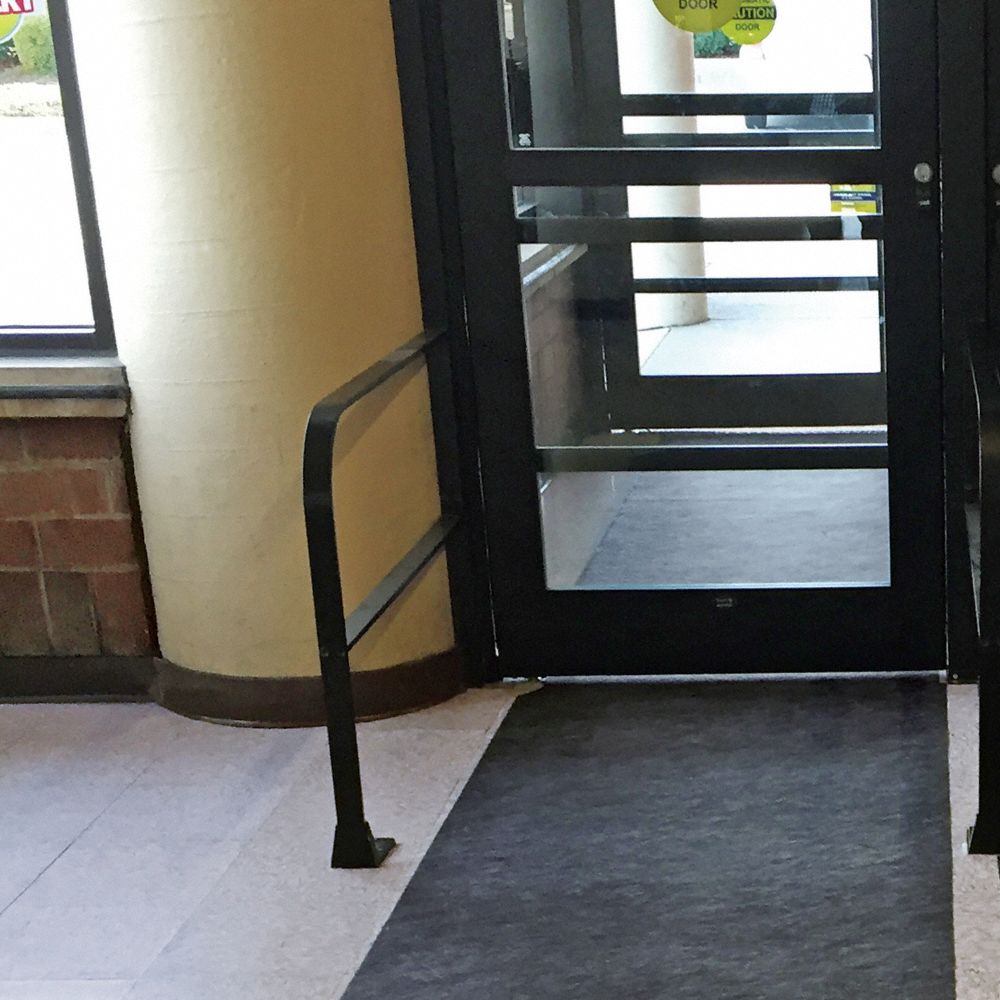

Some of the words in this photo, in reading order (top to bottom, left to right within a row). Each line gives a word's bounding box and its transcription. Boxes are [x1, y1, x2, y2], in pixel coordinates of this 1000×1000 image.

[679, 0, 718, 9] DOOR
[734, 7, 775, 19] UTION
[735, 23, 760, 31] DOOR
